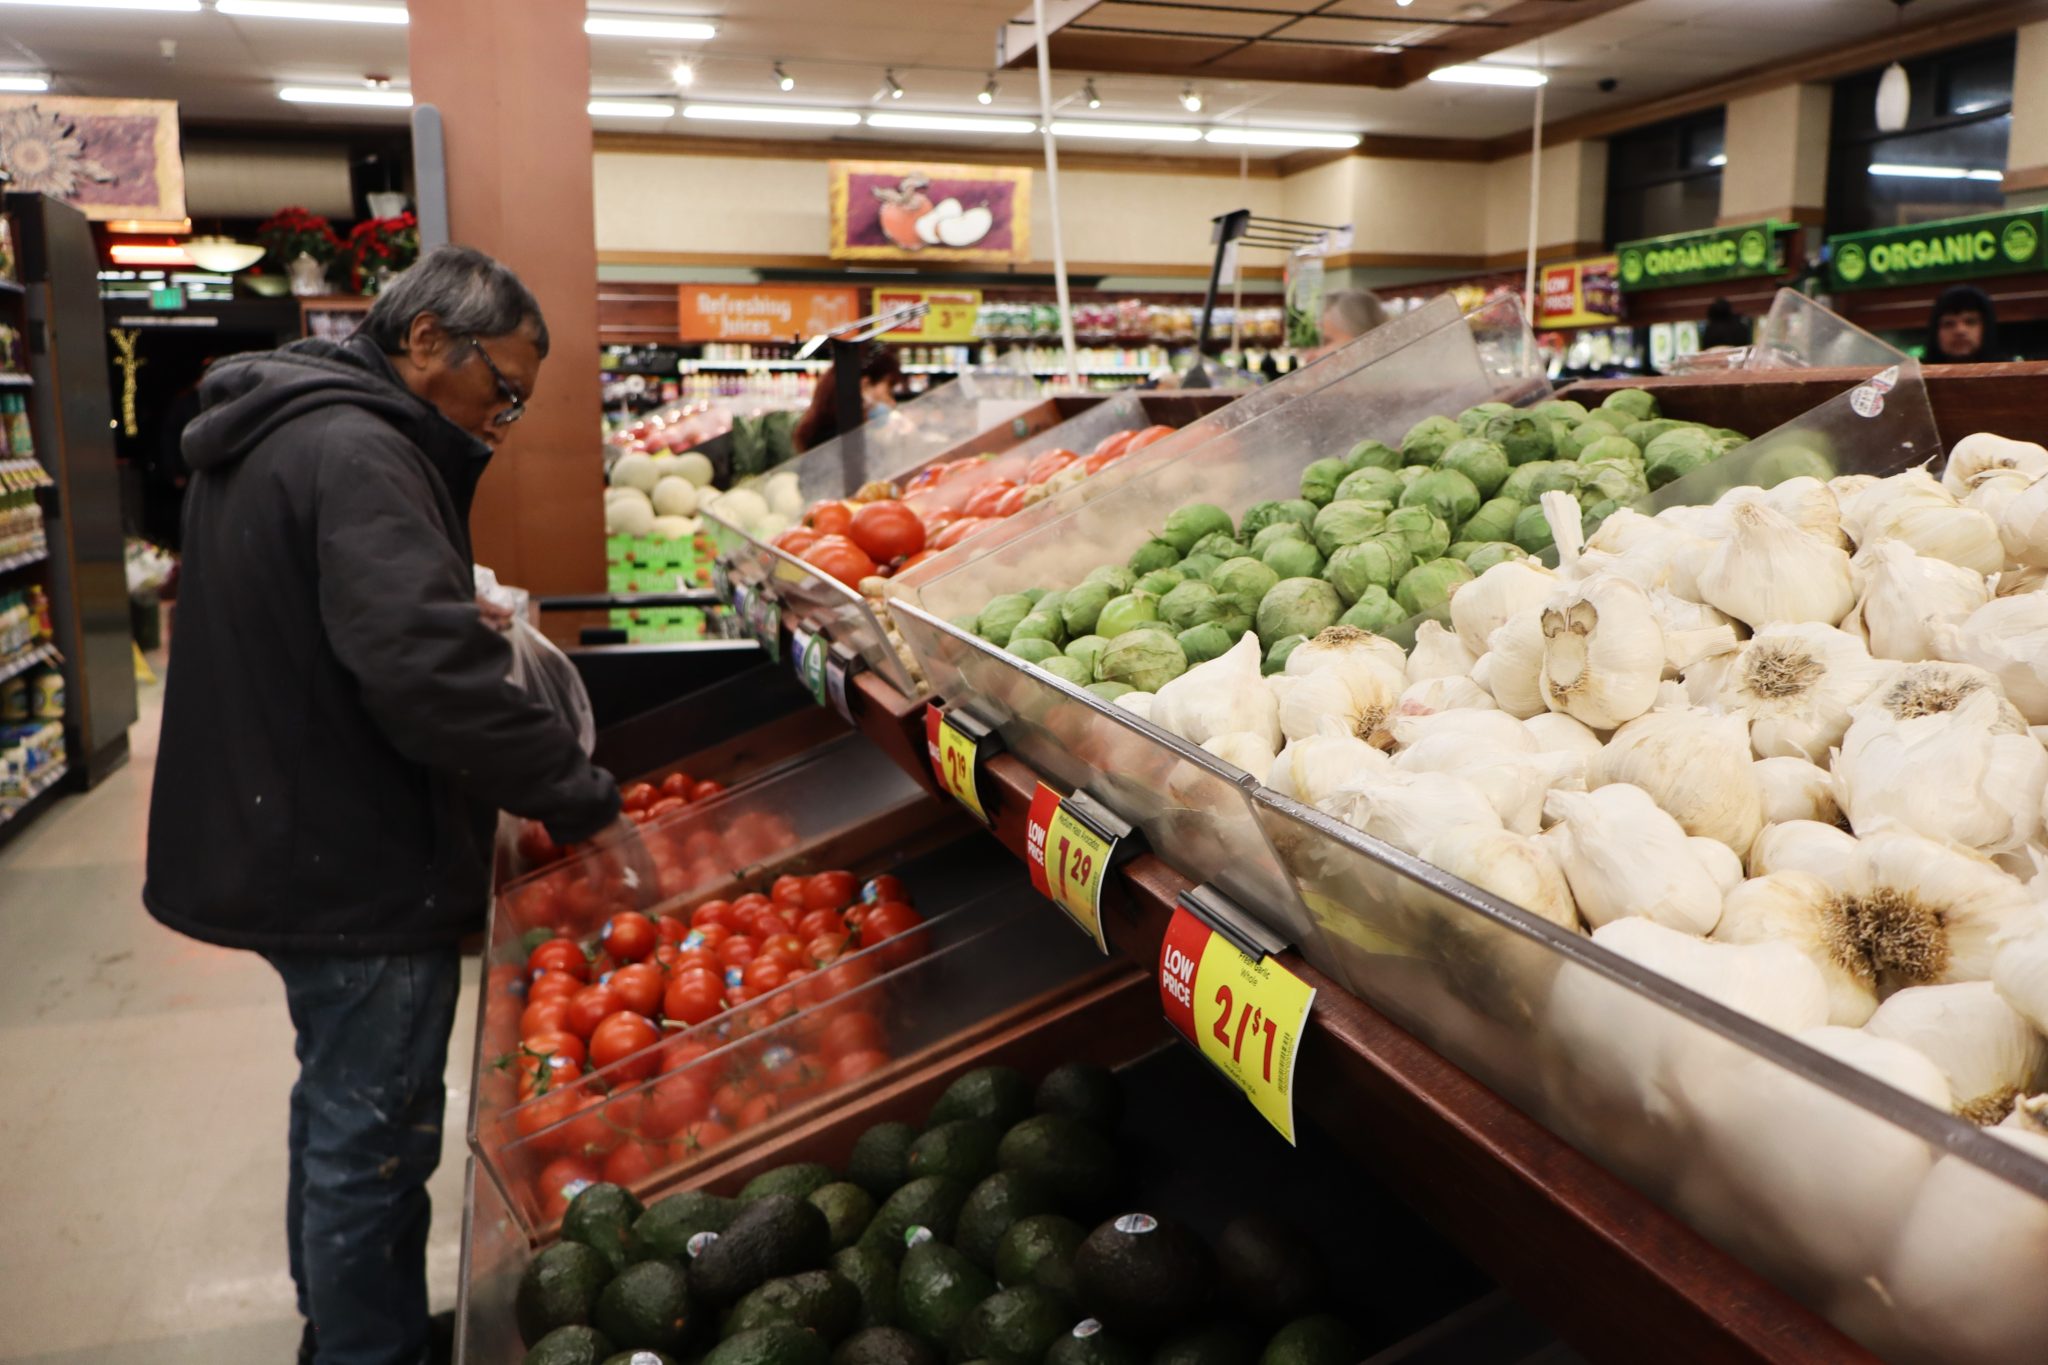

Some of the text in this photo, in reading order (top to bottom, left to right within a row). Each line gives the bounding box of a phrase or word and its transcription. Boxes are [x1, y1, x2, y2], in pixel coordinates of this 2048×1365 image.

[1645, 240, 1737, 276] ORGANIC
[1869, 230, 1996, 273] ORGANIC
[697, 293, 792, 322] Refreshing
[1027, 819, 1046, 848] LOW
[1027, 840, 1045, 867] PRICE
[1165, 944, 1195, 983] LOW
[1162, 969, 1191, 1009] PRICE
